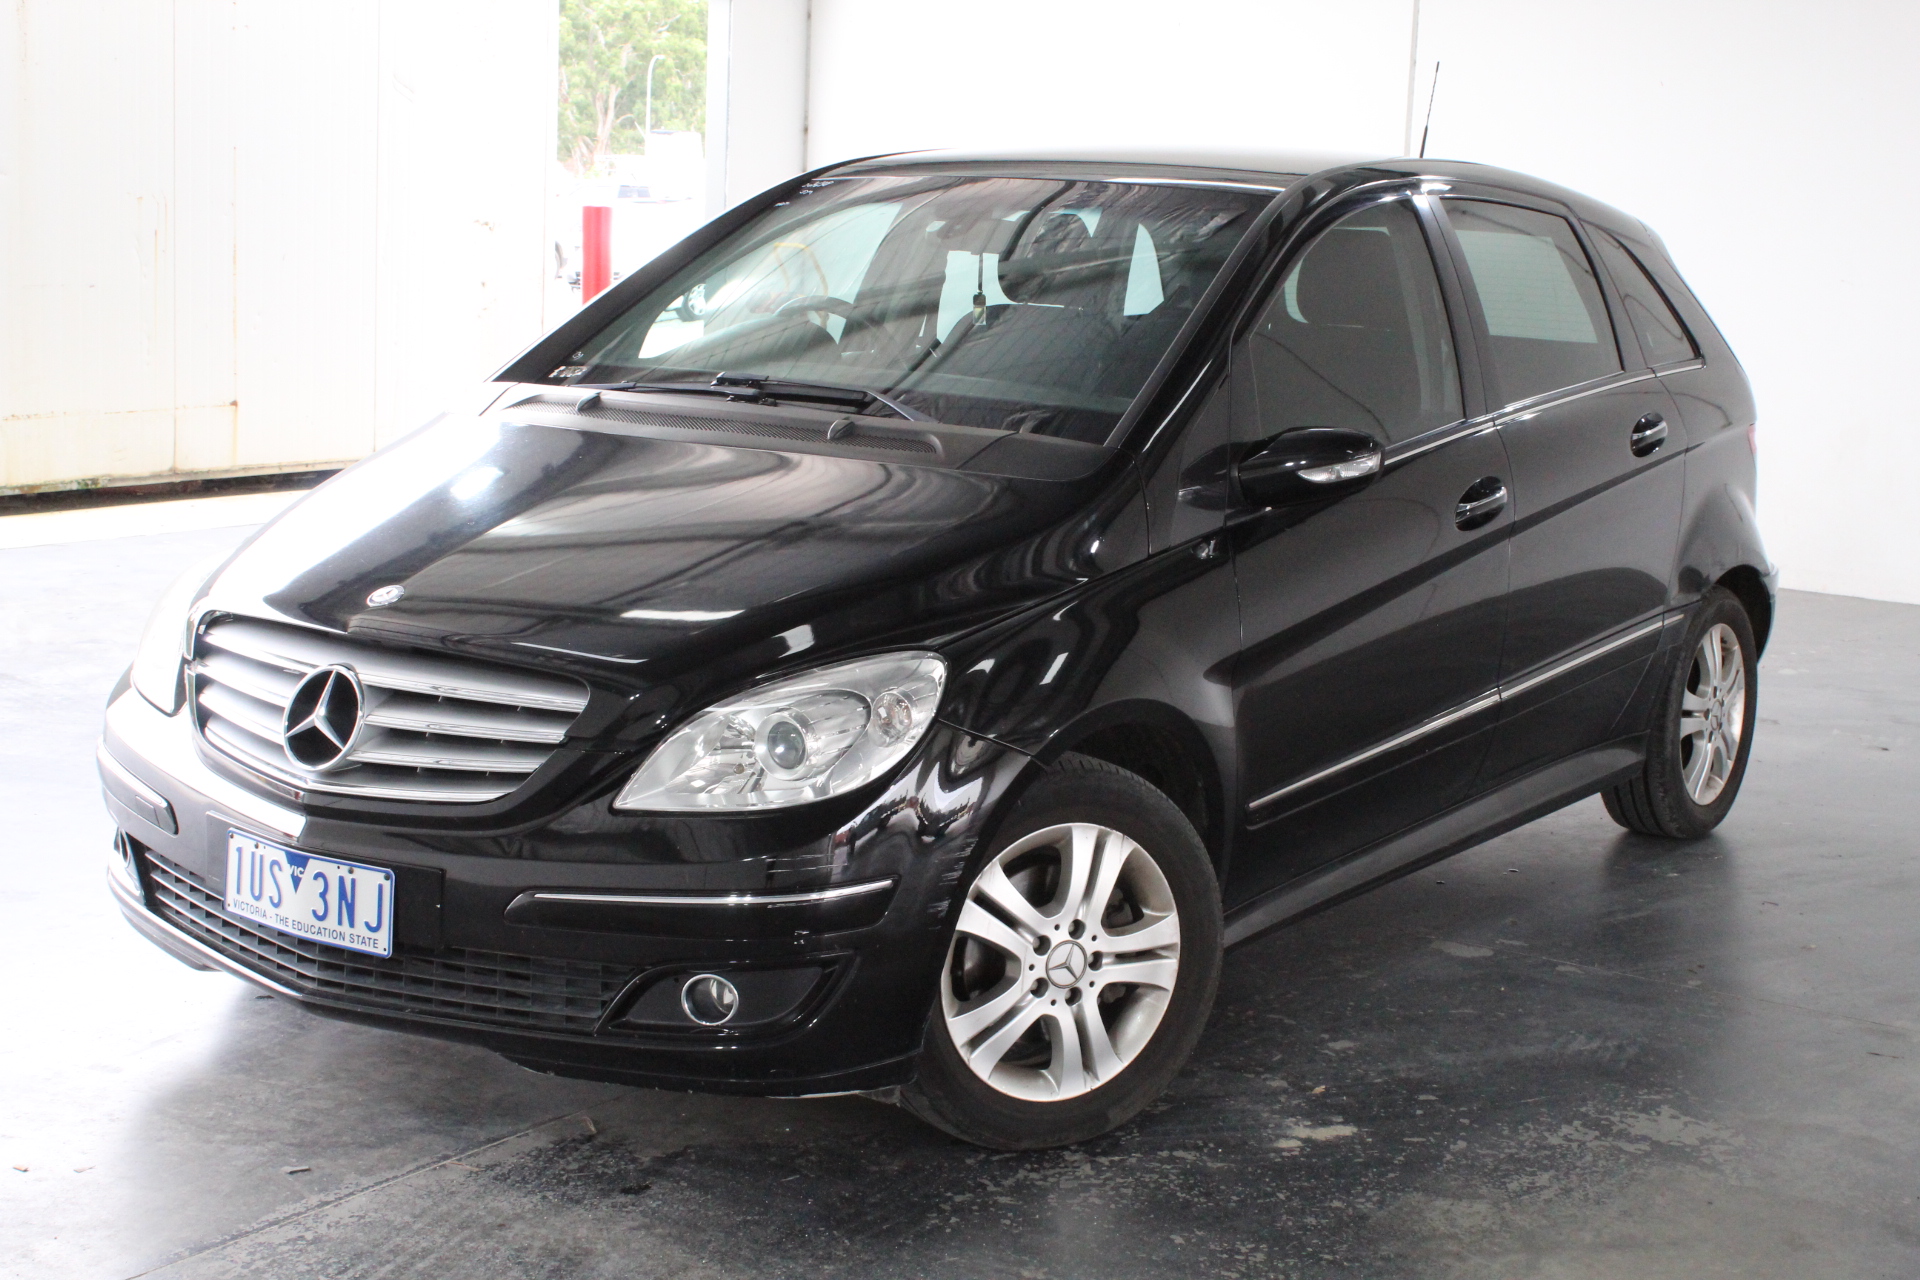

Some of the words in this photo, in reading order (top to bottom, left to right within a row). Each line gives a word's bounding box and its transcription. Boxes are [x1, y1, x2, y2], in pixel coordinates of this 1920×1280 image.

[236, 846, 283, 909] 1US
[311, 870, 384, 933] 3NJ
[289, 864, 305, 878] VIC
[233, 897, 268, 920] VICTORIA
[275, 912, 290, 928] THE
[292, 919, 346, 942] EDUCATION
[349, 932, 379, 949] STATE
